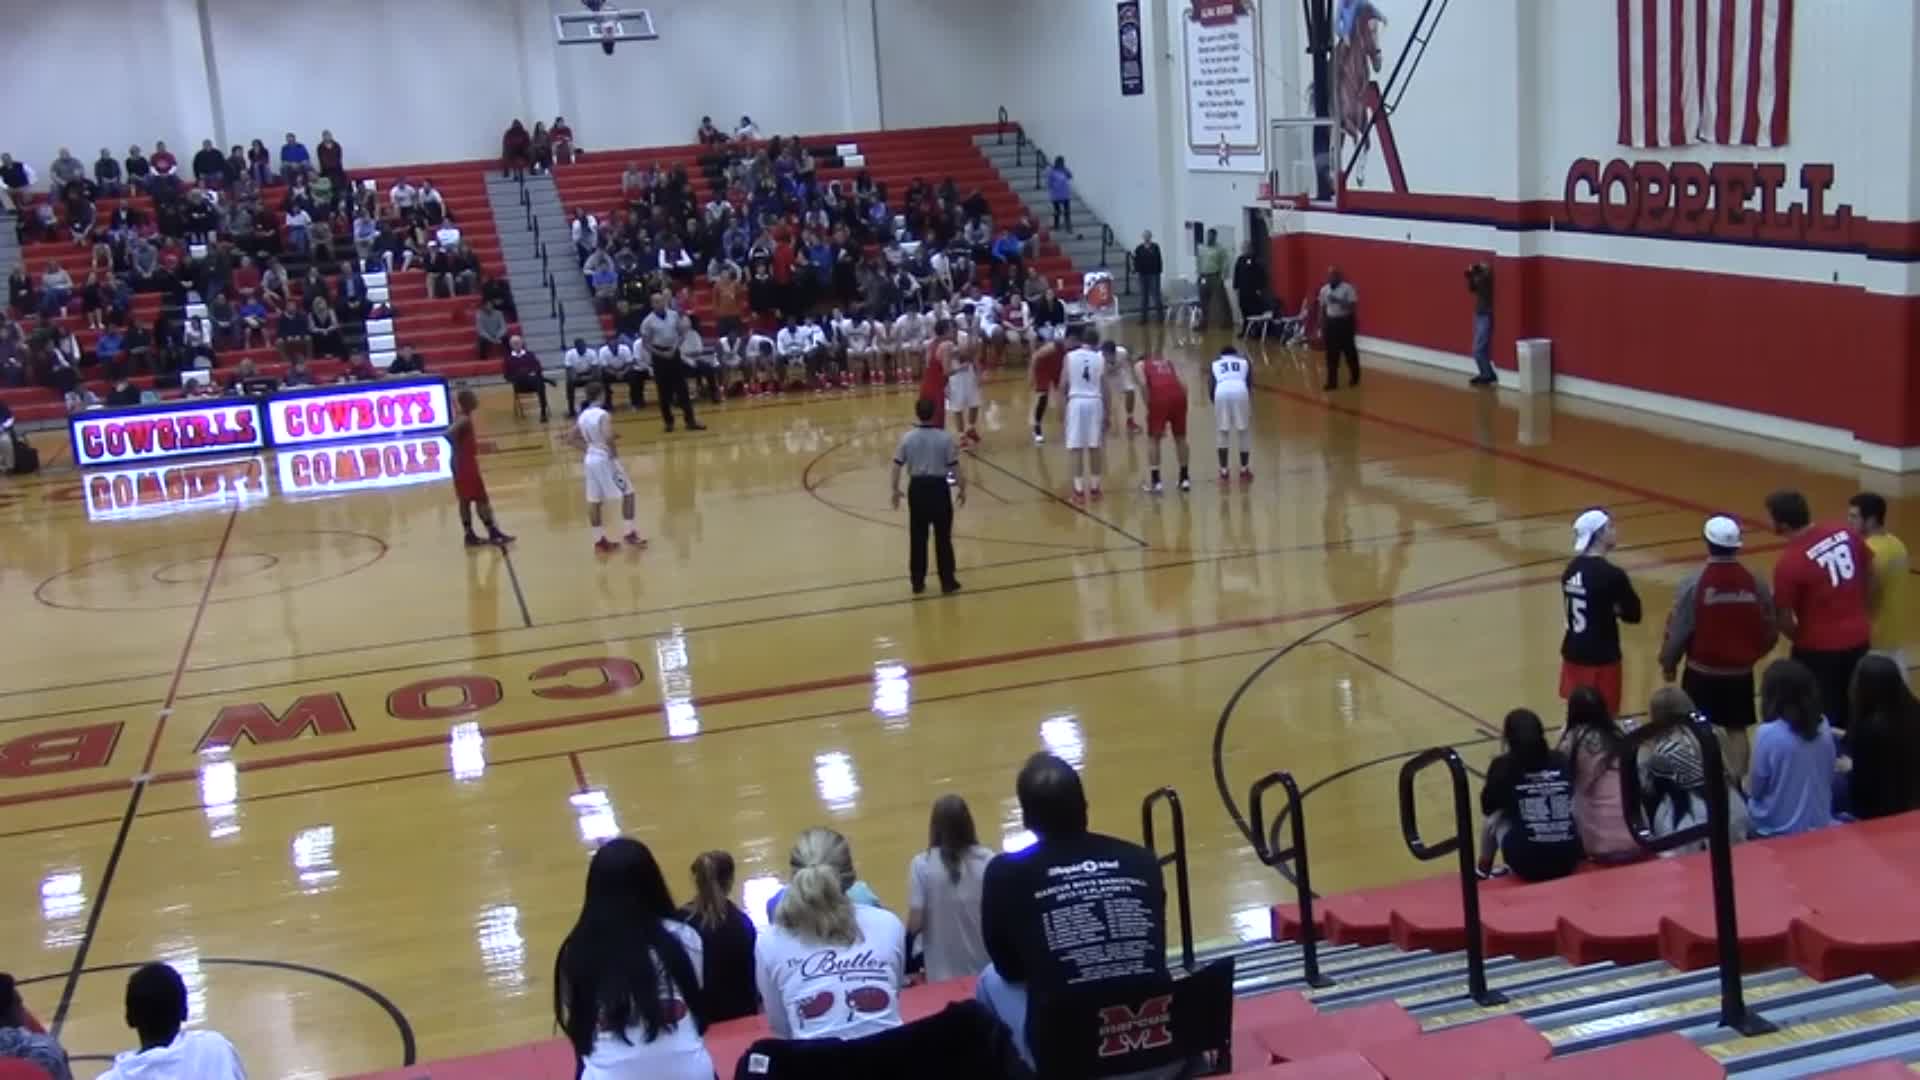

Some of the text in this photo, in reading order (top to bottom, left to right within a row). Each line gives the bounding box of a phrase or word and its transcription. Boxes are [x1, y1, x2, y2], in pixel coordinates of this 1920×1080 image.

[1564, 157, 1852, 239] COPPELL
[1081, 366, 1091, 382] 4
[1219, 361, 1241, 374] 30
[82, 409, 258, 458] COWGIRLS
[284, 391, 436, 437] COWBOYS
[1816, 543, 1855, 588] 78
